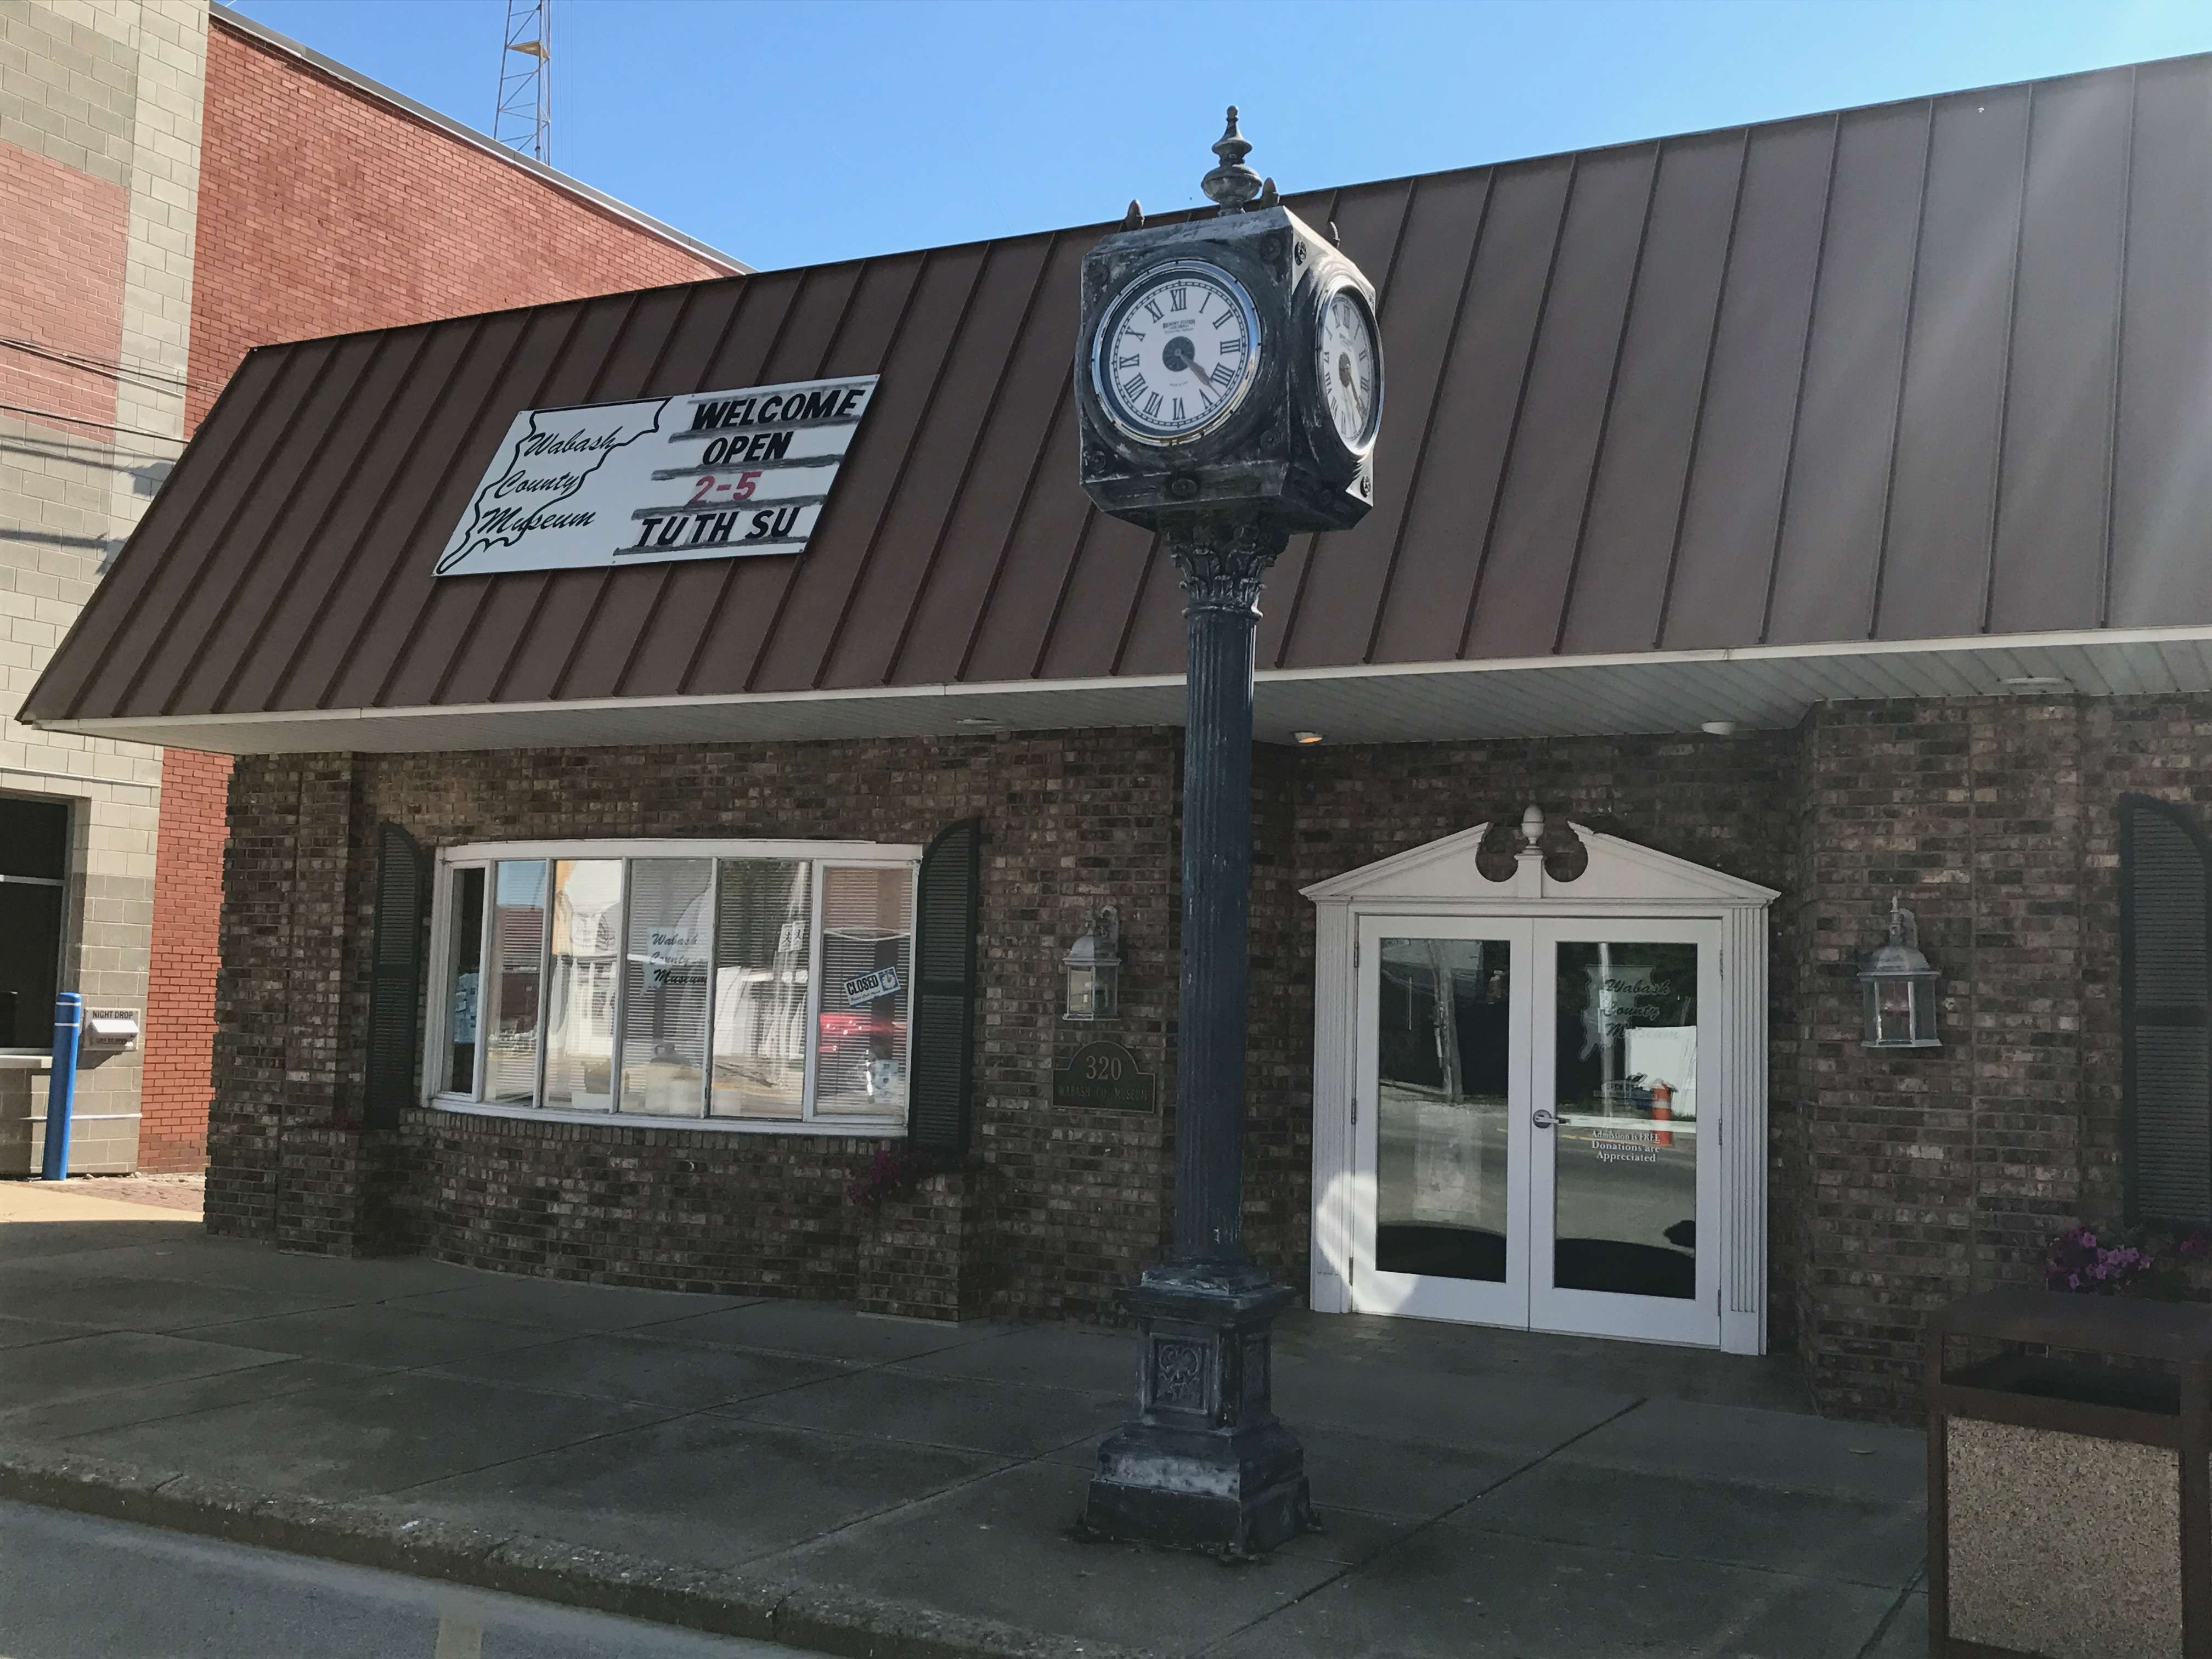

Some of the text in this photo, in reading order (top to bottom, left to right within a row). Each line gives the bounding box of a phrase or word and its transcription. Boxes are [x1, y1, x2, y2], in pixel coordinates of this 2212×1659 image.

[1170, 288, 1187, 312] XII
[1199, 292, 1212, 314] I
[1144, 299, 1165, 324] XI
[1212, 309, 1234, 330] II
[1124, 325, 1146, 342] X
[1220, 338, 1241, 356] III
[1119, 353, 1139, 370] IX
[1210, 362, 1235, 388] IIII
[1124, 372, 1149, 403] VIII
[691, 389, 866, 431] WELCOME
[1142, 391, 1164, 419] VII
[1172, 397, 1186, 421] VI
[1199, 388, 1214, 410] V
[524, 428, 616, 457] Wabash
[702, 431, 794, 466] OPEN
[494, 470, 580, 499] County
[685, 470, 763, 505] 2-5
[477, 506, 596, 534] Museum
[744, 506, 802, 539] SU
[651, 933, 698, 945] Wabash
[653, 968, 707, 983] Museum
[846, 974, 879, 995] CLOSED
[1605, 978, 1671, 995] Wabash
[93, 1011, 134, 1019] NIGHT DROP
[1605, 1000, 1661, 1022] County
[1086, 1055, 1122, 1081] 320
[1592, 1129, 1660, 1142] Admission is FREE
[1592, 1140, 1642, 1152] Donations
[1596, 1151, 1656, 1163] Appreciated
